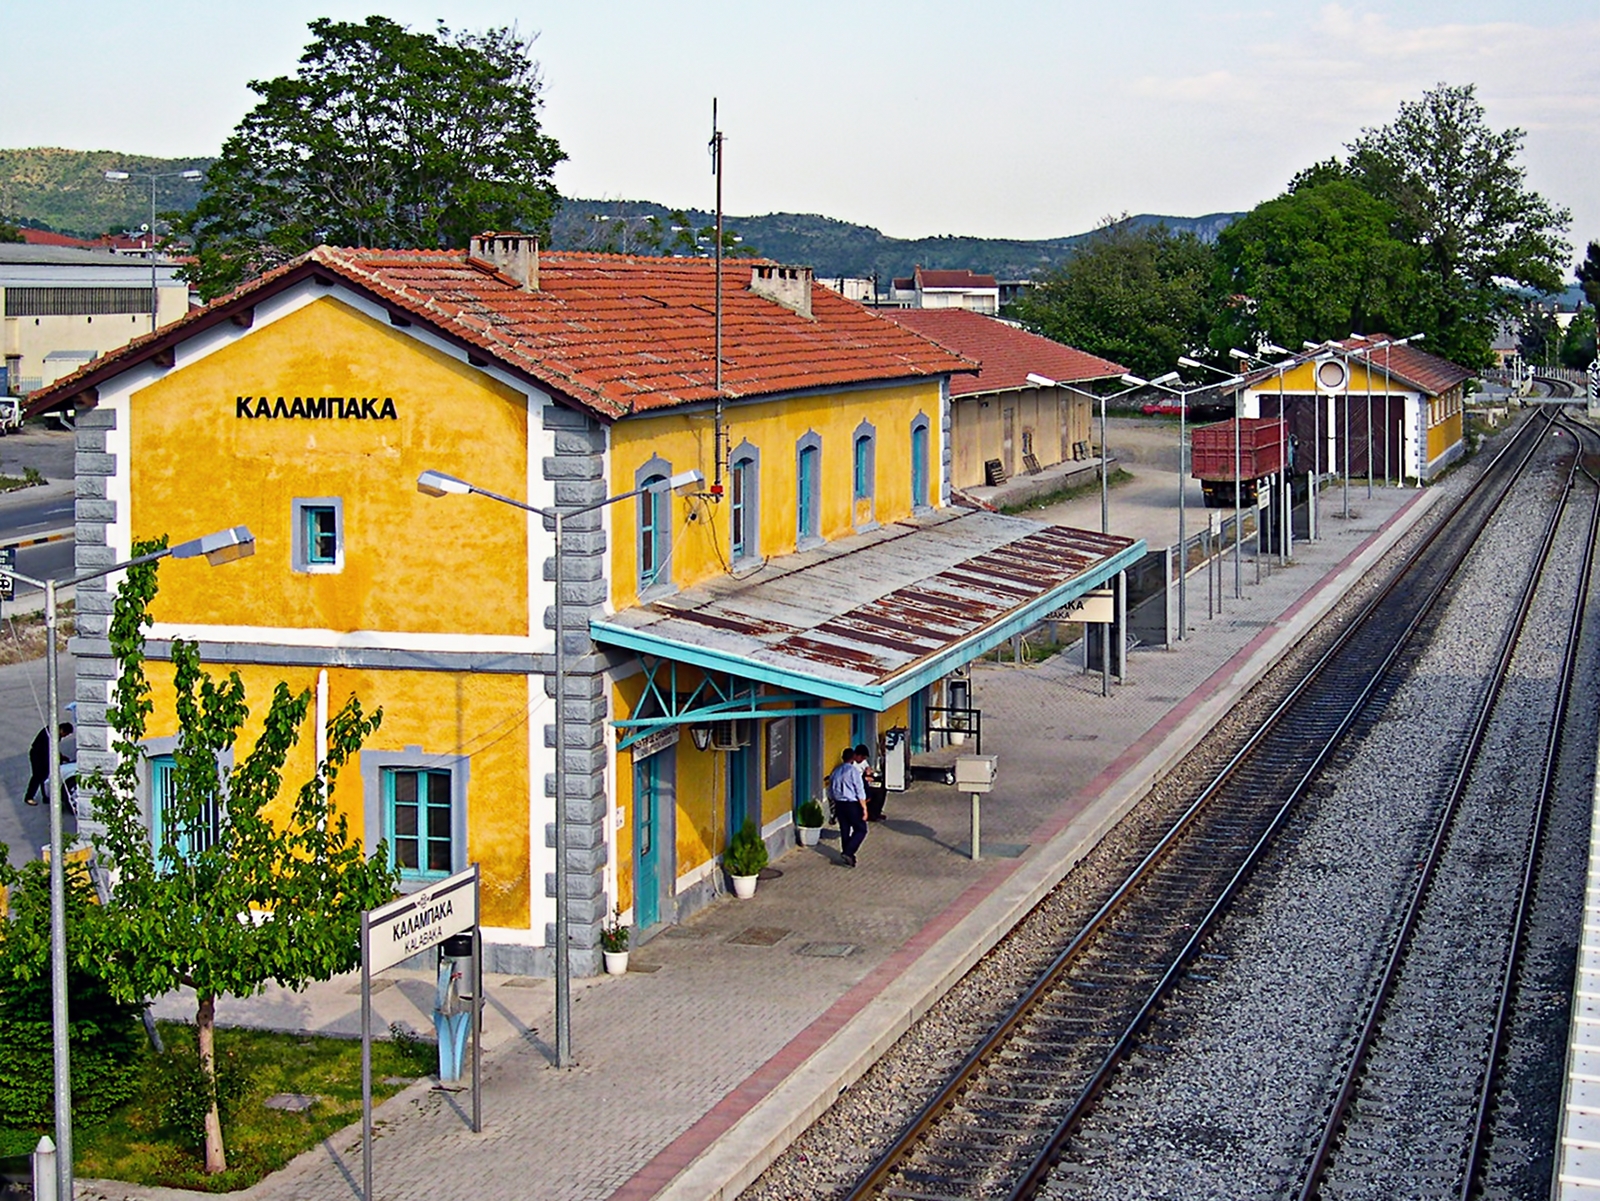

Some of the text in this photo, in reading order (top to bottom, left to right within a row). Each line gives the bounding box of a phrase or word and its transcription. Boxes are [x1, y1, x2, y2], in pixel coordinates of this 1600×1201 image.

[236, 396, 398, 420] ΚΑΛΑΜΠΑΚΑ
[392, 899, 454, 942] ΚΑΛΑΜΠΑΚΑ
[404, 926, 443, 955] KALABAKA
